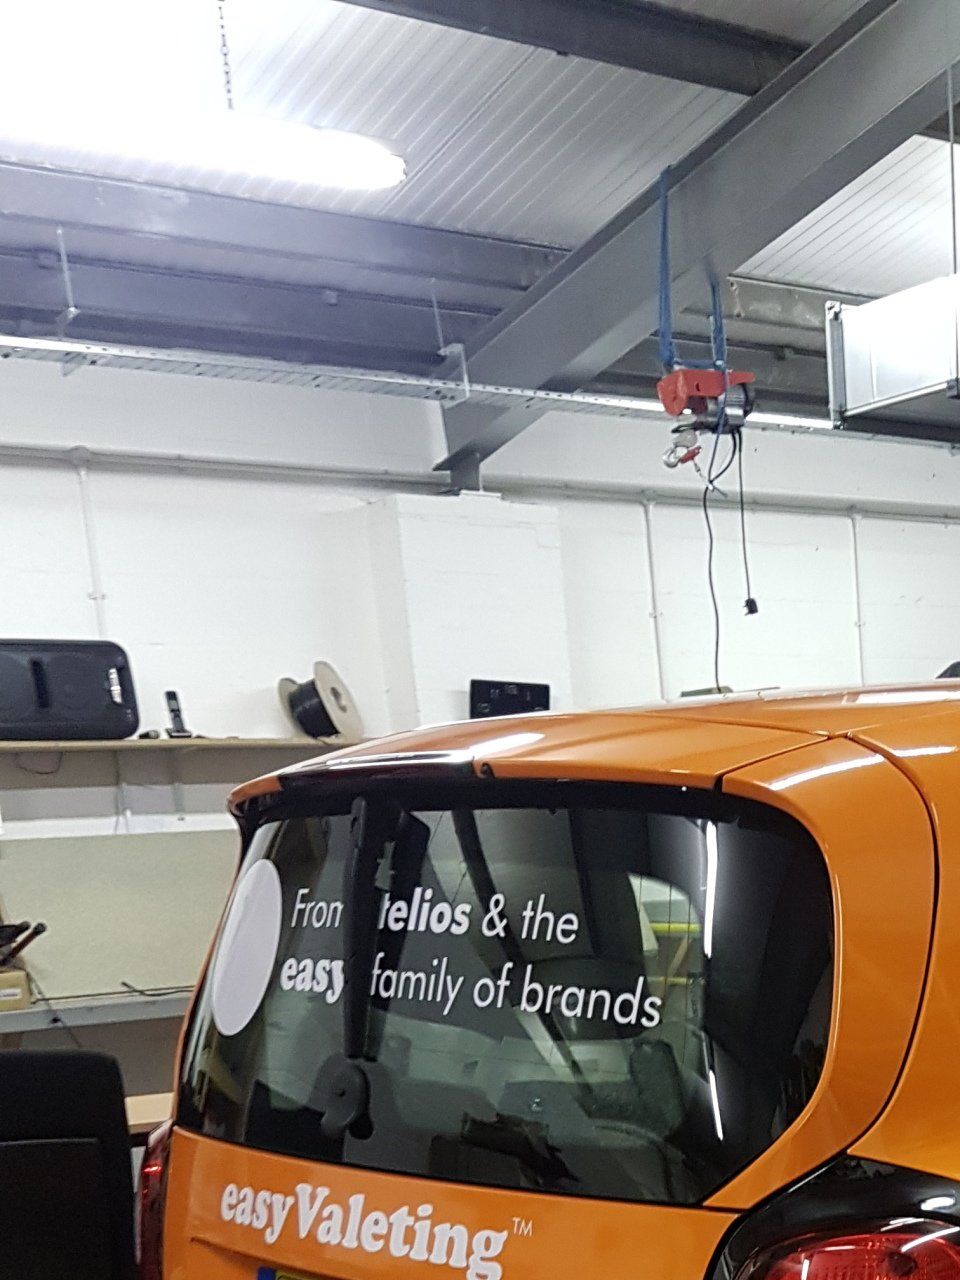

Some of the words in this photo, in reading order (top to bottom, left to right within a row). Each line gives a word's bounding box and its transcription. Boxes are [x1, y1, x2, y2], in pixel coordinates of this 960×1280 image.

[377, 886, 472, 935] telios
[481, 892, 508, 938] &
[520, 892, 580, 944] the
[280, 957, 344, 1004] easy
[370, 952, 464, 1015] family
[472, 961, 514, 1009] of
[520, 971, 663, 1028] brands
